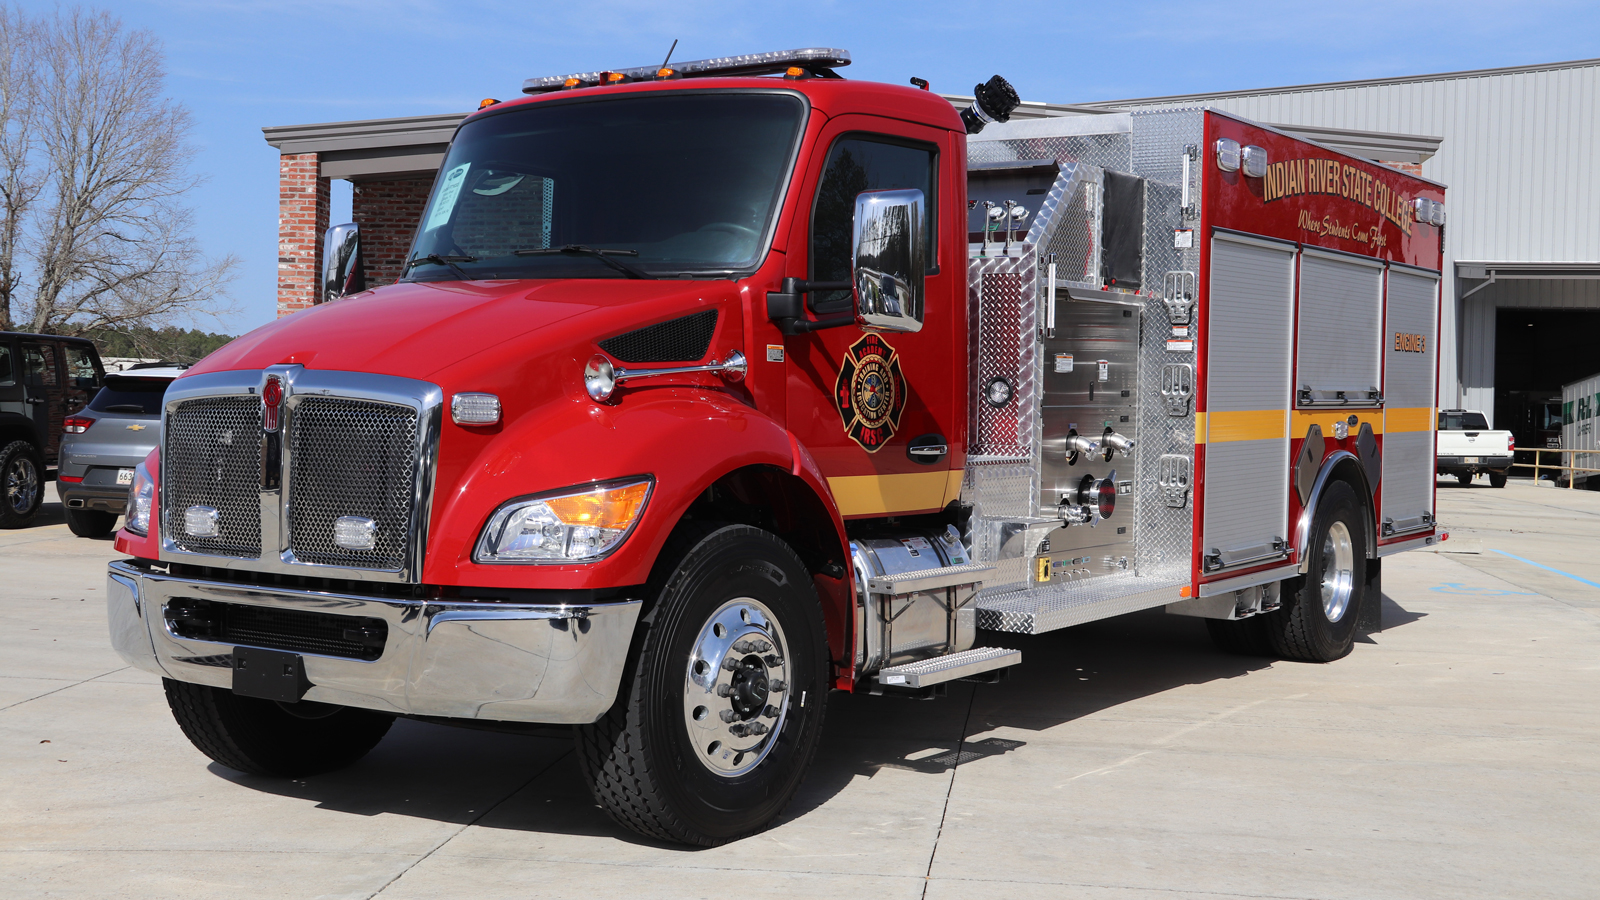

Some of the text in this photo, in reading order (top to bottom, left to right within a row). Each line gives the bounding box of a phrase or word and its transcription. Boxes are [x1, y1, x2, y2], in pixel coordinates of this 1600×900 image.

[1263, 158, 1414, 238] INDIAN RIVER STATE COLLEGE
[1298, 209, 1387, 249] Where Students Come First
[866, 335, 878, 345] FIRE
[1394, 332, 1427, 353] ENGINE 3
[858, 345, 887, 359] ACADEMY
[857, 363, 879, 383] TRAINING
[856, 391, 877, 419] EDUCATION
[859, 426, 884, 446] IRSC
